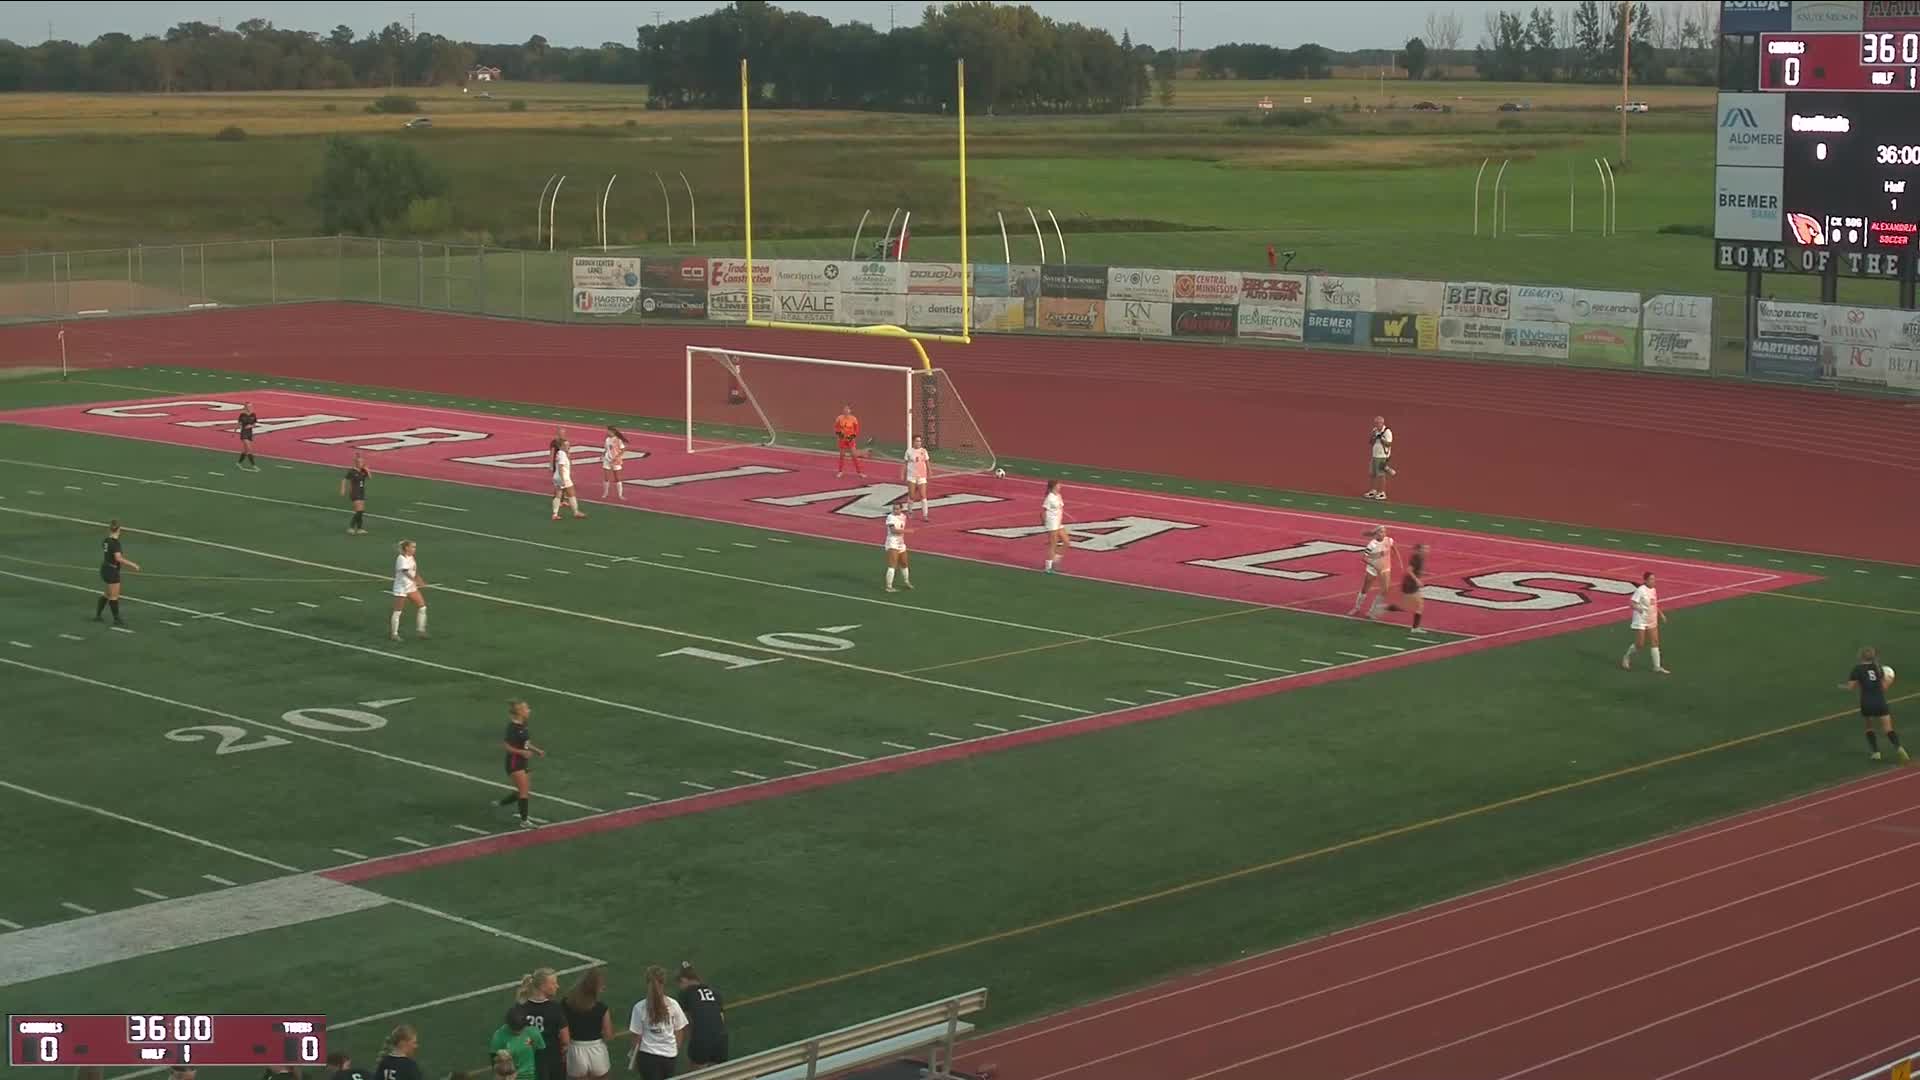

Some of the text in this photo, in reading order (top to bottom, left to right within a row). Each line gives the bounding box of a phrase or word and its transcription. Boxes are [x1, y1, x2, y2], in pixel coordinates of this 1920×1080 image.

[1785, 57, 1800, 86] 0
[1729, 133, 1783, 144] ALOMERE
[1719, 193, 1778, 209] BREMER
[1721, 246, 1898, 275] HOME OF THE
[1195, 275, 1227, 284] CENTRAL
[1195, 284, 1238, 294] MINNESOTA
[1448, 286, 1509, 306] BERG
[781, 293, 835, 312] KVALE
[1125, 303, 1152, 321] KN
[1309, 316, 1352, 328] BREMER
[1520, 328, 1568, 340] Nyberg
[1752, 341, 1818, 356] MARTINSON
[698, 988, 715, 1001] 12
